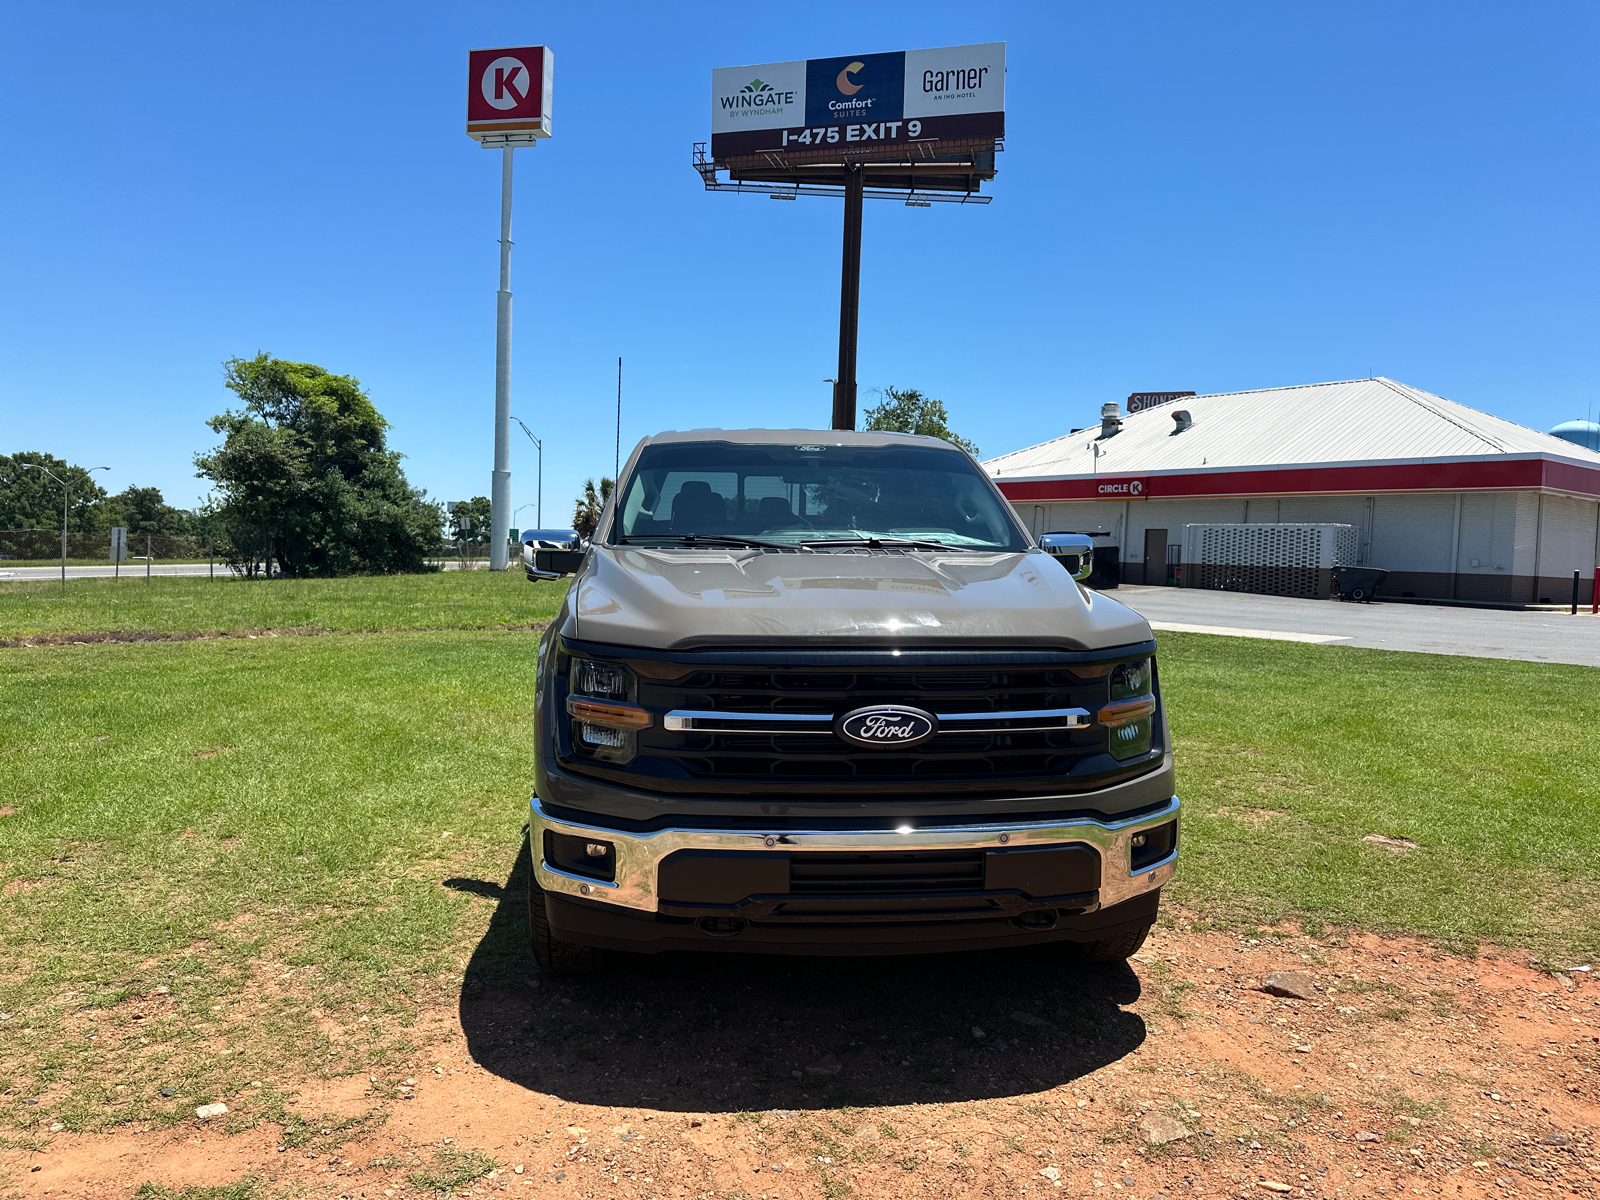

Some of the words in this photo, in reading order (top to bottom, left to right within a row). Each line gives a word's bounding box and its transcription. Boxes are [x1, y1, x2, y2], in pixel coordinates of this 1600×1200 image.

[922, 67, 988, 93] Garner
[720, 91, 794, 109] WINGATE
[828, 98, 872, 110] Comfort
[729, 110, 740, 118] BY
[741, 107, 783, 117] WYNDHAM
[833, 109, 867, 119] SUITES
[782, 126, 840, 147] I-475
[846, 121, 903, 142] EXIT
[907, 120, 922, 138] 9
[1098, 484, 1129, 493] CIRCLE
[1131, 482, 1142, 494] K
[860, 715, 915, 738] Ford
